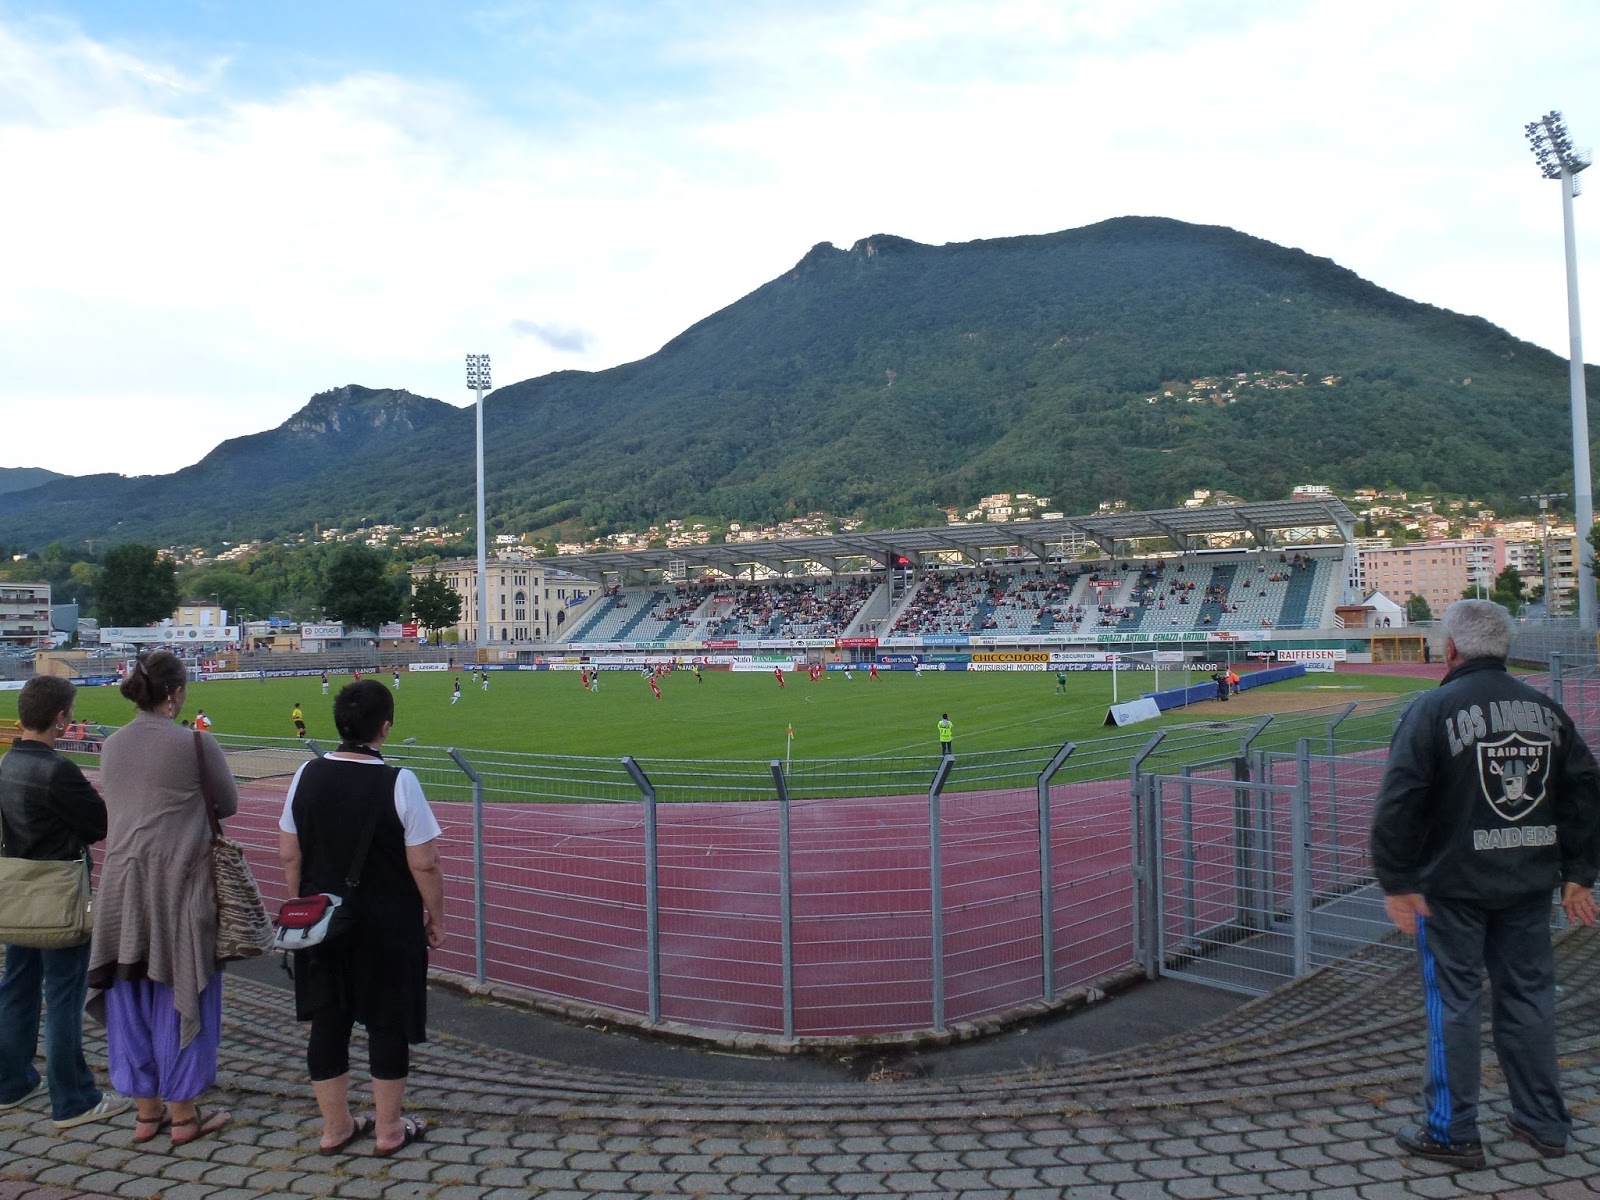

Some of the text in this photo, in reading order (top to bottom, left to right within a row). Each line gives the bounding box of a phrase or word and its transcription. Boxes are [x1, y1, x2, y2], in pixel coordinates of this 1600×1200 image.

[1097, 634, 1122, 642] GENAZZI
[1125, 634, 1150, 642] ARTIOLI
[1152, 633, 1179, 641] GENAZZI
[1182, 632, 1208, 641] ARTIOLI
[1280, 651, 1334, 659] RAIFFEISEN
[1136, 663, 1171, 671] MANOR
[1182, 663, 1218, 671] MANOR
[1446, 704, 1487, 757] LOS
[1487, 746, 1543, 758] RAIDERS
[1473, 825, 1557, 850] RAIDERS
